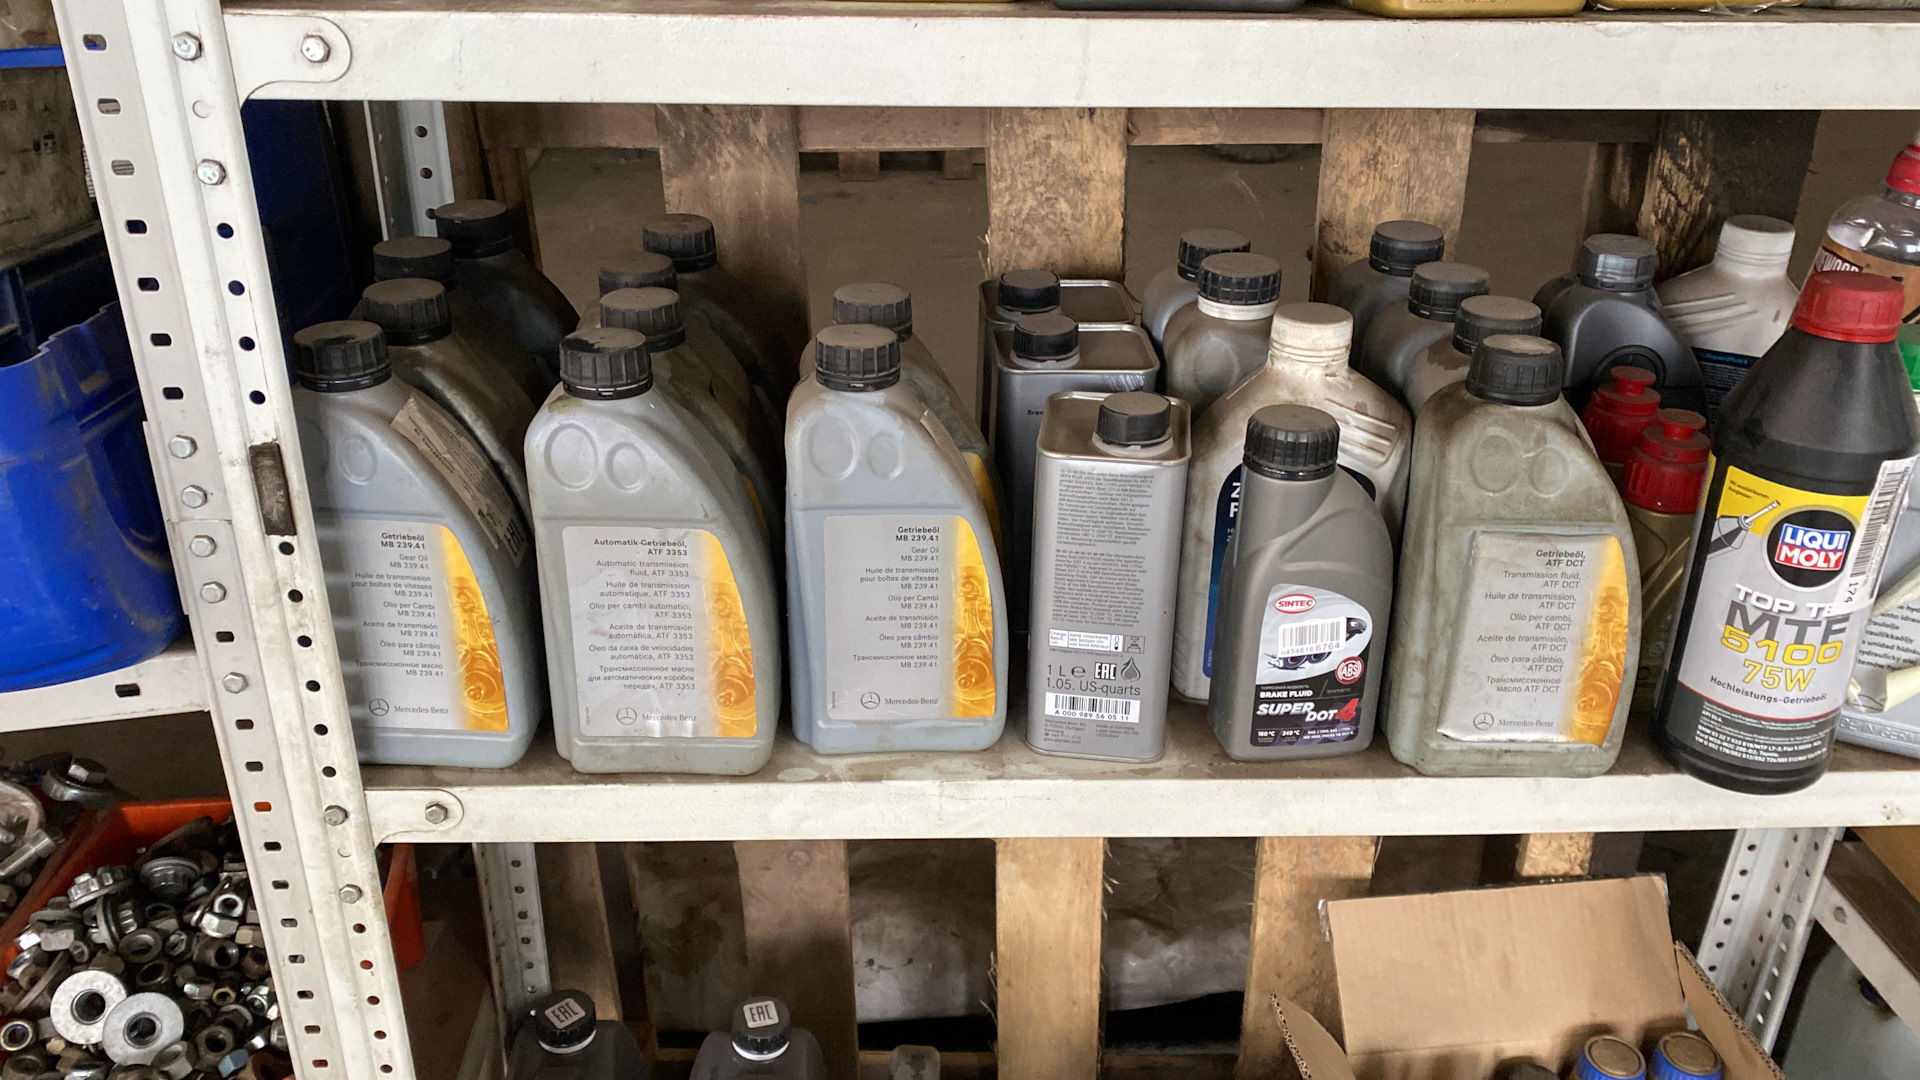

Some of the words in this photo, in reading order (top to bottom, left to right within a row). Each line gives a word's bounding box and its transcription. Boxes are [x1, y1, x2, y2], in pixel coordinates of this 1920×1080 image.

[382, 533, 424, 541] Getriebeöl
[1784, 526, 1847, 550] LIQUI
[594, 539, 687, 548] Automatik-Getriebeöl,
[1536, 550, 1585, 559] Getriebeöl,
[1779, 548, 1844, 568] MOLY
[630, 569, 649, 577] fluid,
[1504, 571, 1558, 579] Transmission
[1561, 572, 1581, 580] fluid,
[404, 582, 432, 590] vitesses
[1485, 592, 1506, 600] Huile
[1521, 593, 1576, 601] transmission,
[1736, 583, 1795, 612] TOP
[1807, 602, 1836, 617] TE
[413, 602, 435, 610] Cambi
[649, 603, 691, 611] automatici,
[1278, 599, 1312, 607] SINTEC
[1545, 614, 1572, 622] cambi,
[1723, 599, 1850, 645] MTF
[648, 623, 692, 631] transmisión
[1518, 635, 1568, 643] transmisión,
[589, 644, 606, 652] Óleo
[1721, 625, 1843, 666] 5100
[1868, 641, 1894, 650] unidad
[356, 660, 419, 668] Трансмиссионное
[1491, 655, 1510, 663] Óleo
[1532, 656, 1564, 664] câmbio,
[1048, 665, 1052, 675] 1
[1060, 665, 1066, 676] L
[1095, 662, 1116, 680] EAC
[1342, 665, 1358, 678] ABS
[1743, 660, 1815, 692] 75W
[1047, 678, 1075, 690] 1.05.
[1080, 681, 1140, 696] US-quarts
[1711, 675, 1827, 704] Hochleistungs-Getriebeöl
[394, 706, 448, 714] Mercedes-Benz
[1256, 702, 1315, 716] SUPER
[1499, 719, 1553, 727] Mercedes-Benz
[551, 1002, 578, 1023] EAC
[749, 1005, 772, 1022] EAC
